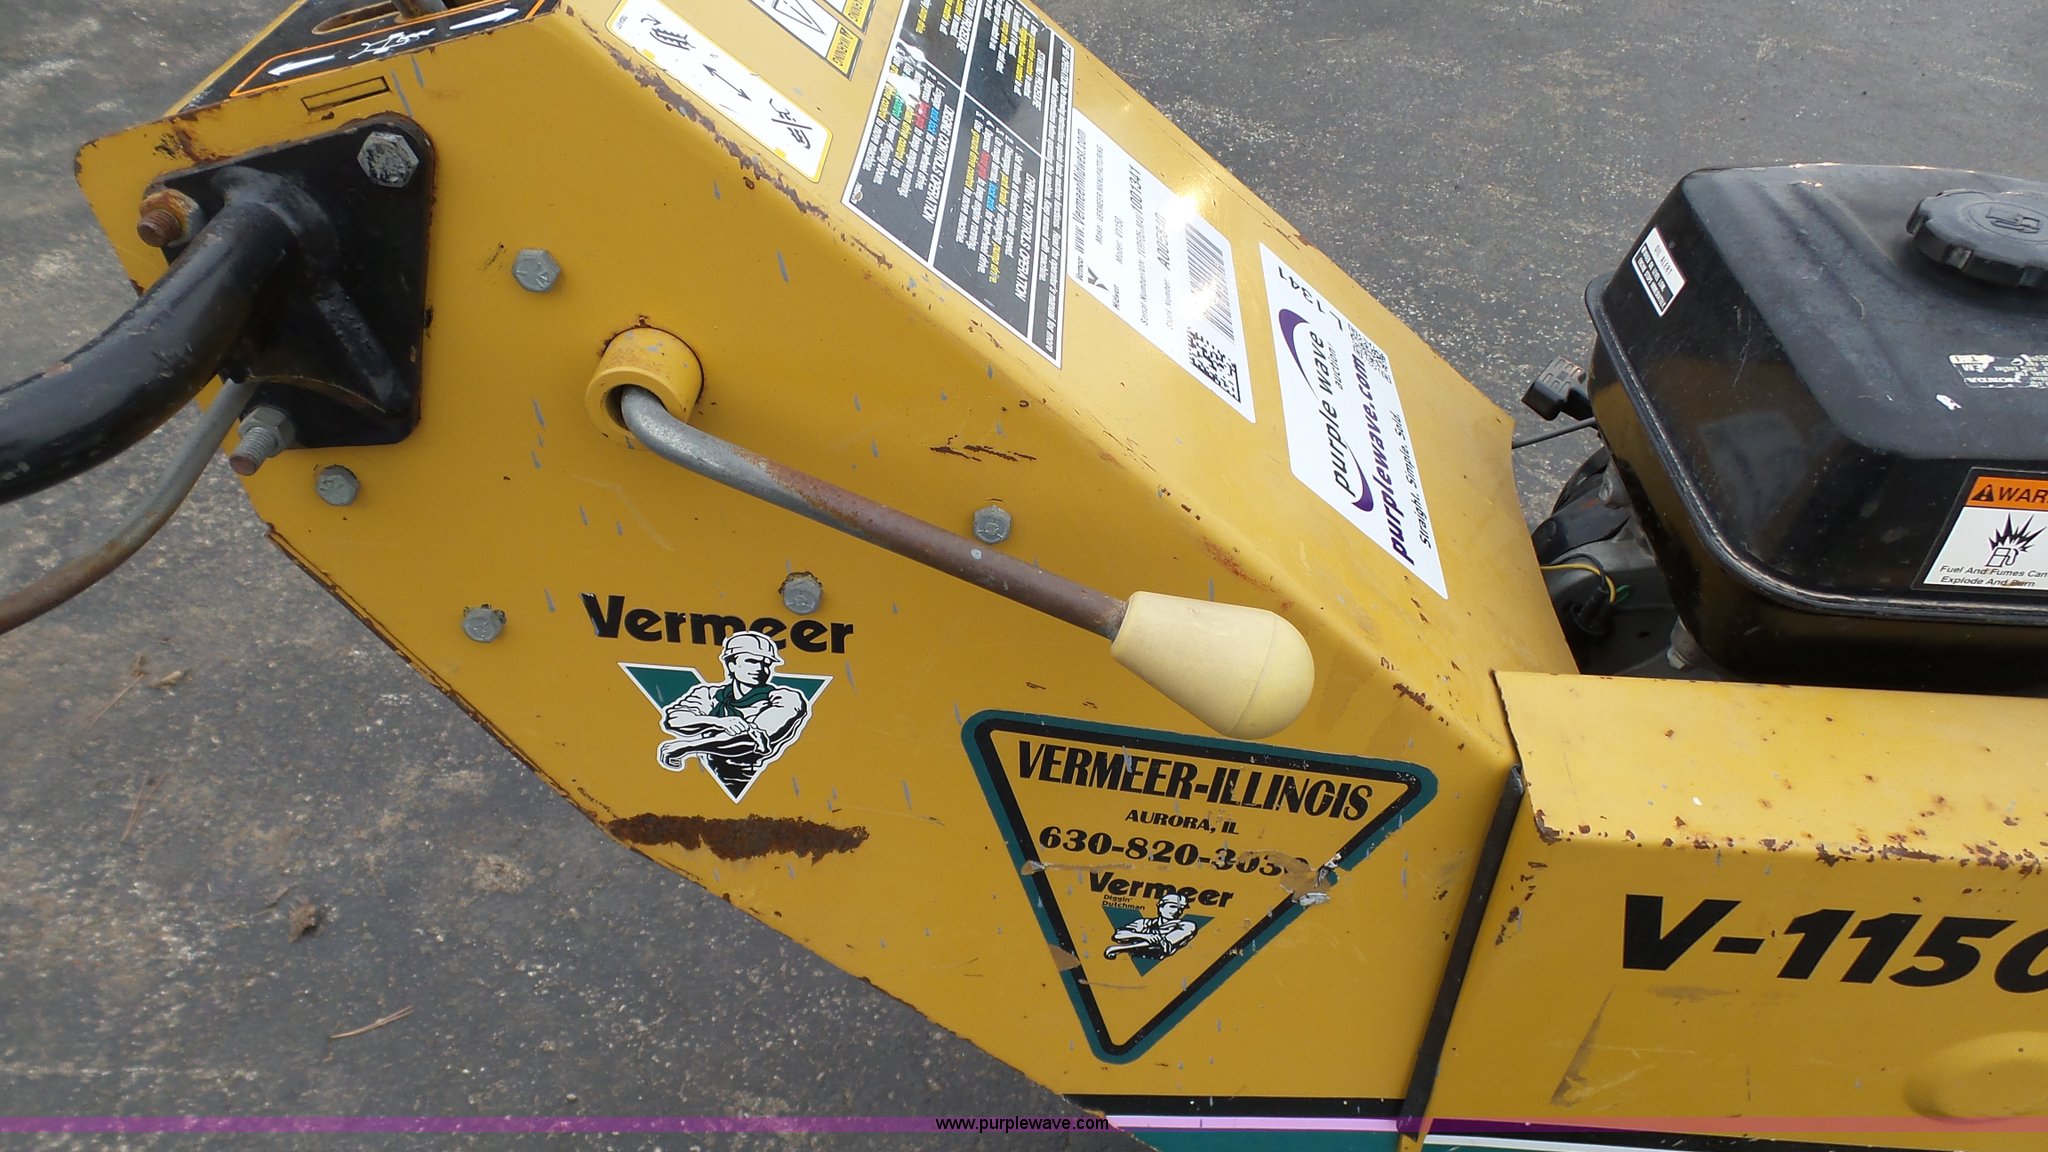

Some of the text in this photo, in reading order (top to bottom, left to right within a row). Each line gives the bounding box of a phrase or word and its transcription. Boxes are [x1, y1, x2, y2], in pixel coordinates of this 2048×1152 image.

[832, 36, 853, 67] WARNING
[877, 97, 889, 121] control
[889, 115, 899, 125] to
[875, 117, 885, 127] to
[899, 120, 911, 138] drive
[913, 126, 923, 136] to
[870, 124, 882, 144] move
[909, 133, 921, 151] keep
[925, 131, 935, 144] for
[862, 141, 877, 171] machine.
[877, 139, 893, 166] digging
[894, 136, 906, 162] control
[905, 148, 917, 172] engine
[919, 141, 933, 175] two-wheel
[872, 163, 888, 184] boom.
[889, 165, 899, 177] on.
[892, 157, 902, 168] to
[922, 104, 954, 223] DIGGING CONTROLS OPERATION
[897, 169, 912, 197] running.
[914, 171, 927, 190] drive.
[964, 165, 974, 190] control
[976, 176, 986, 186] to
[963, 186, 972, 196] to
[1072, 128, 1086, 253] www.VermeerMidwest.com
[960, 193, 970, 214] move
[971, 199, 982, 223] engine
[984, 208, 994, 222] for
[994, 203, 1006, 215] by
[955, 212, 967, 243] machine.
[965, 221, 978, 251] running.
[1014, 172, 1035, 301] DRIVING CONTROLS OPERATION
[1114, 215, 1123, 238] V1150
[977, 253, 988, 273] drive.
[988, 240, 1000, 265] pump
[1075, 255, 1083, 281] Vermeer
[1659, 255, 1672, 275] ALERT
[1046, 318, 1055, 332] for
[1139, 301, 1148, 326] Serial
[1045, 330, 1053, 352] more
[1309, 331, 1355, 496] purple wave
[1352, 354, 1413, 564] purplewave.com
[1389, 410, 1431, 548] Straight. Simple. Sold.
[1999, 486, 2048, 503] WAR
[1940, 565, 2048, 578] Fuel And Fumes Can
[1940, 576, 1983, 585] Explode
[1985, 578, 2008, 586] And
[579, 592, 854, 654] Vermeer
[1019, 741, 1373, 821] VERMEER-ILLINOIS
[1125, 809, 1239, 835] AURORA, IL
[1090, 872, 1234, 907] Vermeer
[1103, 894, 1133, 904] Diggin'
[1102, 900, 1145, 911] Dutchman
